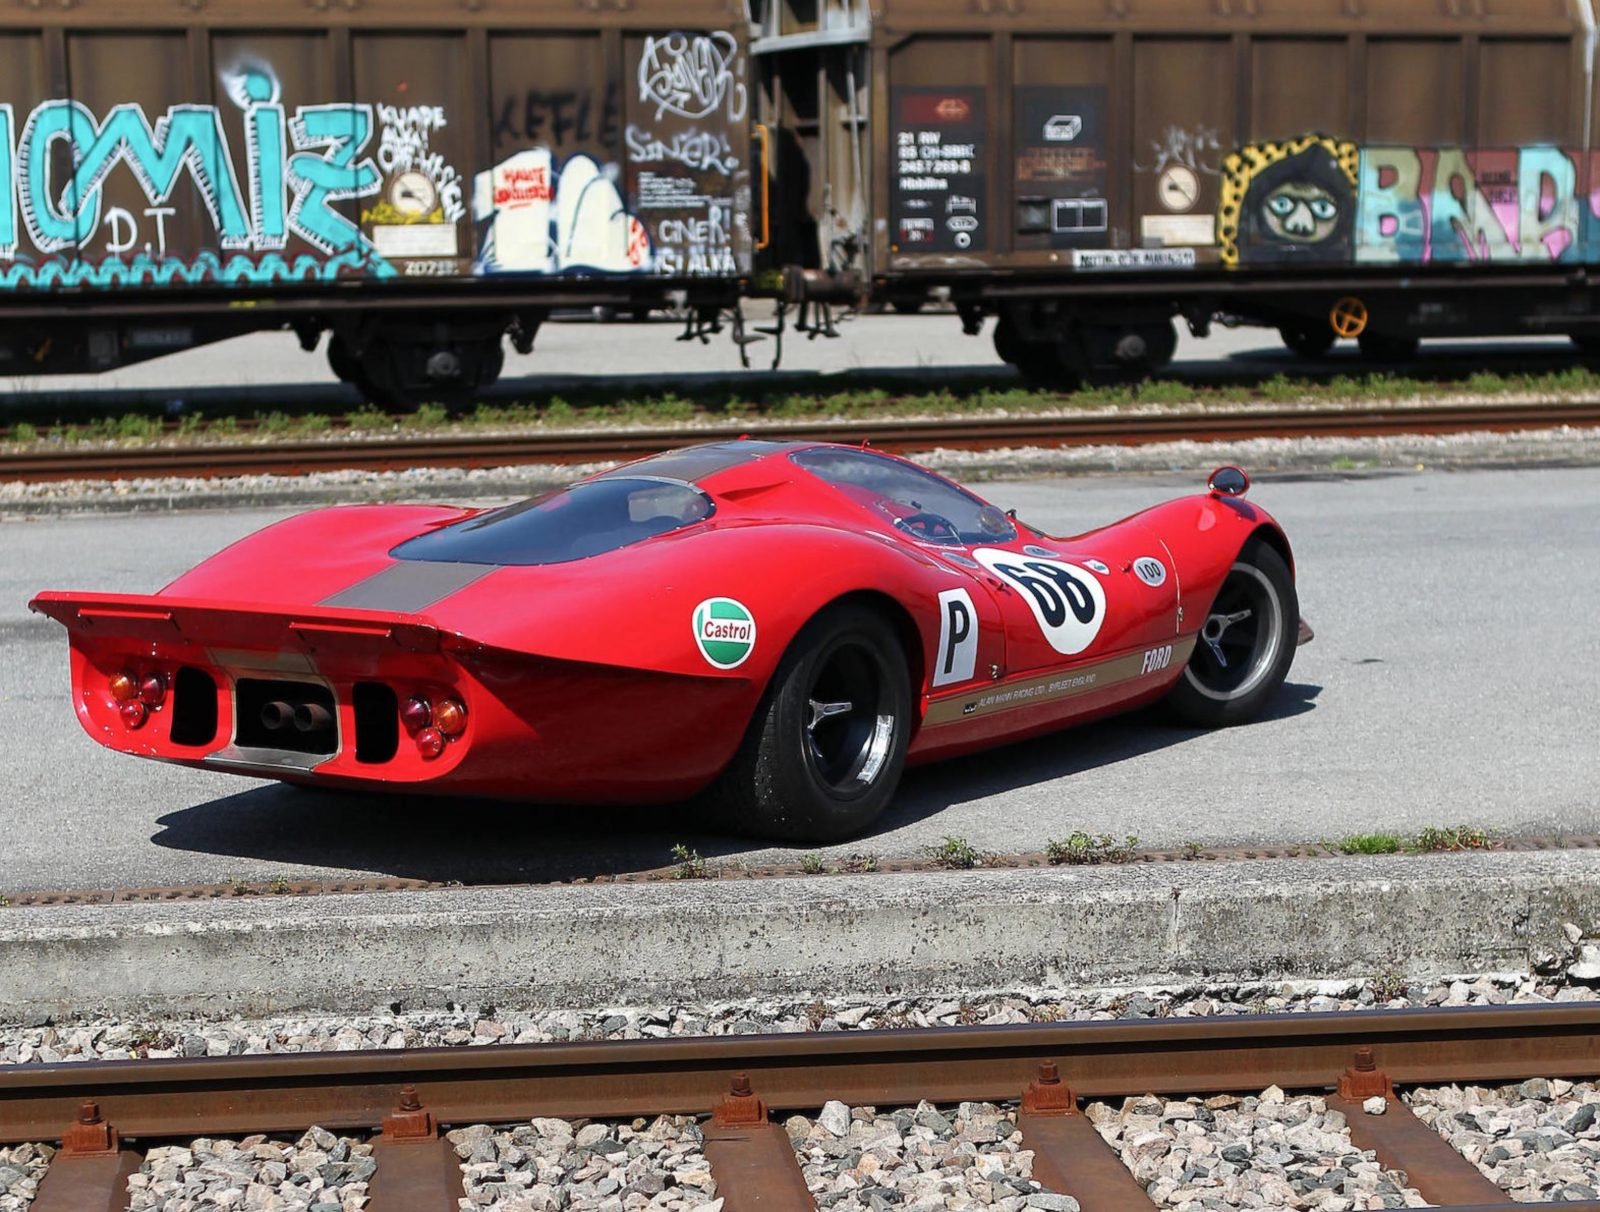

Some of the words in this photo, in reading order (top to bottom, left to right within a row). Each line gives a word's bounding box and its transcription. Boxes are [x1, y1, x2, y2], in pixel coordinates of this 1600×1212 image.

[1138, 562, 1161, 580] 100
[993, 561, 1096, 627] 68
[704, 621, 751, 640] Castrol
[943, 600, 970, 675] P
[1140, 645, 1172, 675] FORD
[1012, 687, 1034, 700] RACING
[1071, 673, 1097, 688] ENGLAND
